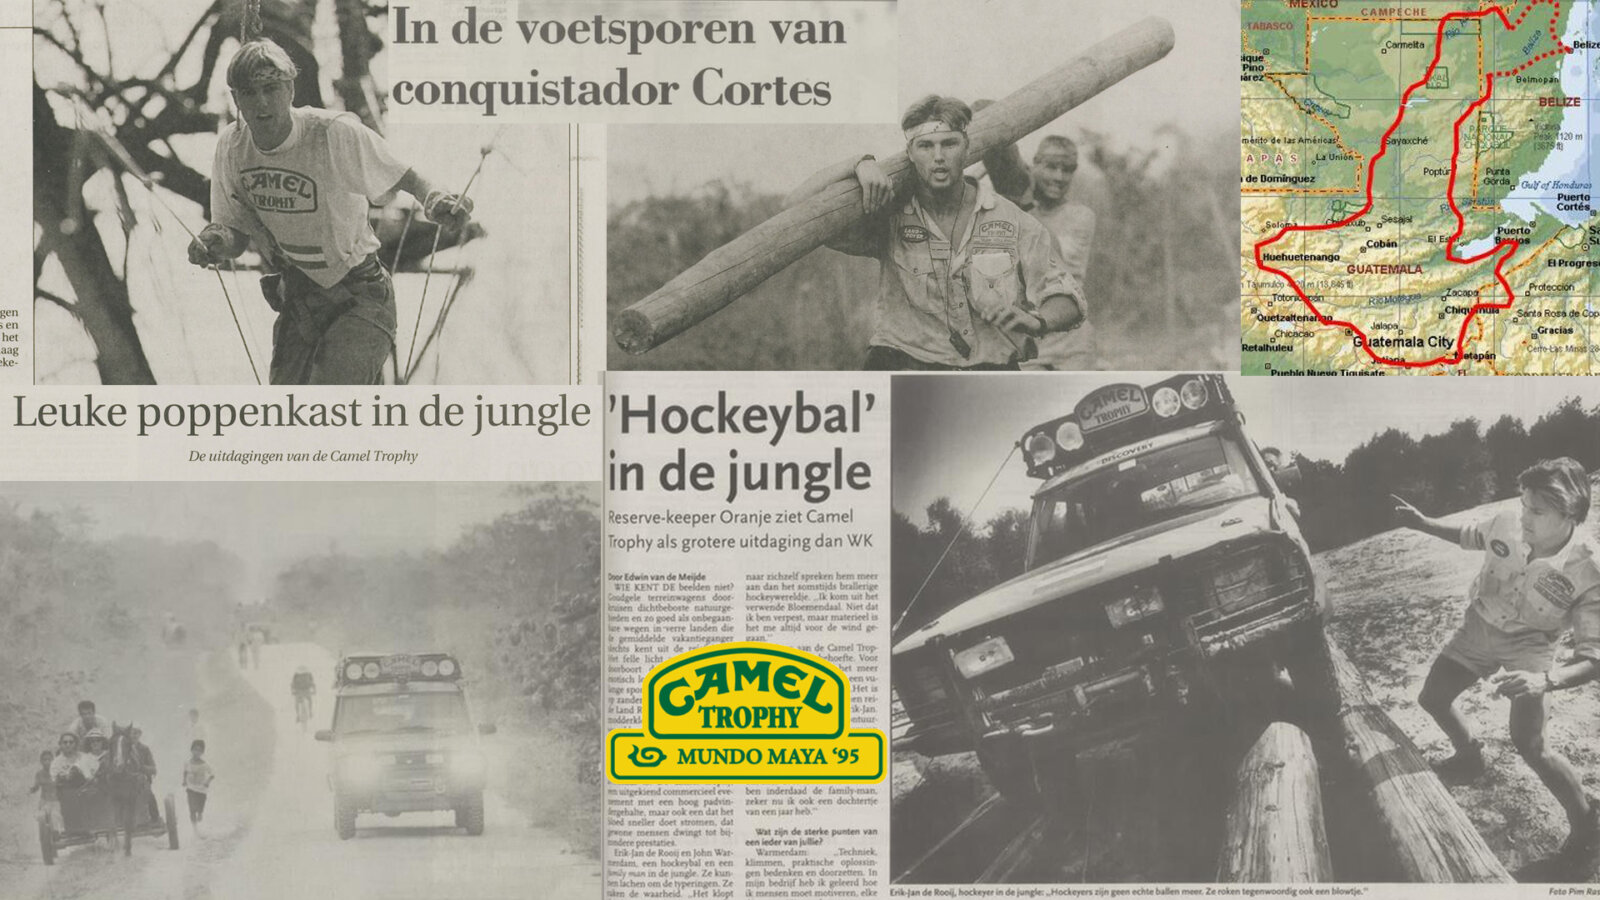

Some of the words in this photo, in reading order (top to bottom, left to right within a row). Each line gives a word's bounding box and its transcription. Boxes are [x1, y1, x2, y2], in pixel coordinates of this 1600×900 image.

[1361, 8, 1427, 16] CAMPECHE
[392, 6, 438, 44] In
[452, 6, 503, 44] de
[517, 15, 756, 55] voetsporen
[770, 19, 847, 44] van
[1247, 22, 1293, 30] TABASCO
[1385, 40, 1425, 49] Carmelita
[1243, 63, 1264, 72] Pino
[1516, 76, 1560, 85] Belmopan
[392, 67, 680, 117] conquistador
[692, 67, 832, 106] Cortes
[1540, 97, 1581, 107] BELIZE
[1386, 136, 1429, 146] Sayaxché
[1329, 153, 1354, 161] Unión
[1486, 167, 1511, 176] Punta
[1246, 175, 1258, 183] de
[1260, 174, 1315, 184] Domínguez
[1483, 177, 1511, 186] Gorda
[1521, 180, 1540, 190] Gulf
[1541, 180, 1552, 190] of
[1552, 180, 1593, 189] Honduras
[1557, 193, 1591, 202] Puerto
[1557, 202, 1591, 211] Cortés
[1497, 227, 1531, 235] Puerto
[1366, 239, 1397, 248] Cobán
[1428, 235, 1439, 243] El
[1263, 253, 1340, 262] Huehuetenango
[1548, 259, 1556, 267] El
[1347, 265, 1423, 274] GUATEMALA
[1529, 283, 1575, 291] Protección
[1446, 288, 1479, 297] Zacapa
[1517, 309, 1541, 318] Santa
[1544, 309, 1566, 318] Rosa
[1569, 309, 1580, 318] de
[1371, 322, 1399, 331] Jalapa
[1537, 326, 1574, 335] Gracias
[2, 332, 18, 342] het
[1274, 329, 1315, 338] Chicacao
[1428, 335, 1455, 350] City
[1, 347, 19, 356] aag
[1241, 344, 1293, 352] Retalhuleu
[1081, 388, 1141, 420] CAMEL
[13, 394, 127, 428] Leuke
[137, 394, 361, 437] poppenkast
[372, 394, 409, 428] in
[419, 394, 464, 428] de
[472, 394, 592, 437] jungle
[1094, 404, 1131, 424] TROPHY
[1101, 441, 1153, 464] DISCOVERY
[189, 450, 206, 462] De
[209, 450, 284, 466] uitdagingen
[286, 453, 310, 462] van
[312, 450, 328, 462] de
[330, 449, 371, 462] Camel
[373, 450, 419, 466] Trophy
[609, 448, 644, 491] in
[659, 448, 715, 491] de
[726, 447, 872, 503] jungle
[608, 510, 716, 527] Reserve-keeper
[719, 509, 772, 527] Oranje
[775, 509, 802, 524] ziet
[806, 508, 853, 524] Camel
[608, 534, 653, 552] Trophy
[657, 534, 677, 548] als
[681, 536, 736, 552] grotere
[739, 533, 811, 552] uitdaging
[814, 533, 843, 548] dan
[847, 533, 873, 548] WK
[624, 573, 649, 581] Edwin
[666, 573, 677, 581] de
[679, 573, 706, 582] Meijde
[767, 572, 800, 581] zichzelf
[801, 572, 834, 582] spreken
[836, 572, 854, 581] hem
[857, 573, 878, 581] meer
[679, 583, 711, 591] beelden
[714, 583, 735, 591] niet?
[756, 828, 771, 836] Wat
[774, 828, 788, 837] zijn
[791, 828, 801, 836] de
[804, 827, 829, 836] sterke
[831, 828, 860, 837] punten
[762, 838, 781, 846] ieder
[799, 838, 824, 847] jullie?
[614, 849, 644, 858] Erik-Jan
[646, 849, 656, 857] de
[658, 849, 680, 858] Rooij
[693, 849, 713, 858] John
[714, 849, 734, 857] War-
[890, 888, 920, 897] Erik-Jan
[922, 888, 932, 896] de
[934, 888, 957, 898] Rooij,
[958, 888, 994, 897] hockeyer
[996, 888, 1003, 896] in
[1005, 888, 1015, 896] de
[1016, 888, 1044, 897] jungle:
[1094, 888, 1109, 897] zijn
[1110, 889, 1130, 897] geen
[1132, 888, 1155, 896] echte
[1156, 887, 1180, 896] ballen
[1205, 888, 1216, 896] Ze
[1217, 887, 1240, 895] roken
[1242, 888, 1297, 897] tegenwoordig
[1299, 887, 1314, 895] ook
[1549, 887, 1567, 896] Foto
[1568, 887, 1584, 896] Pim
